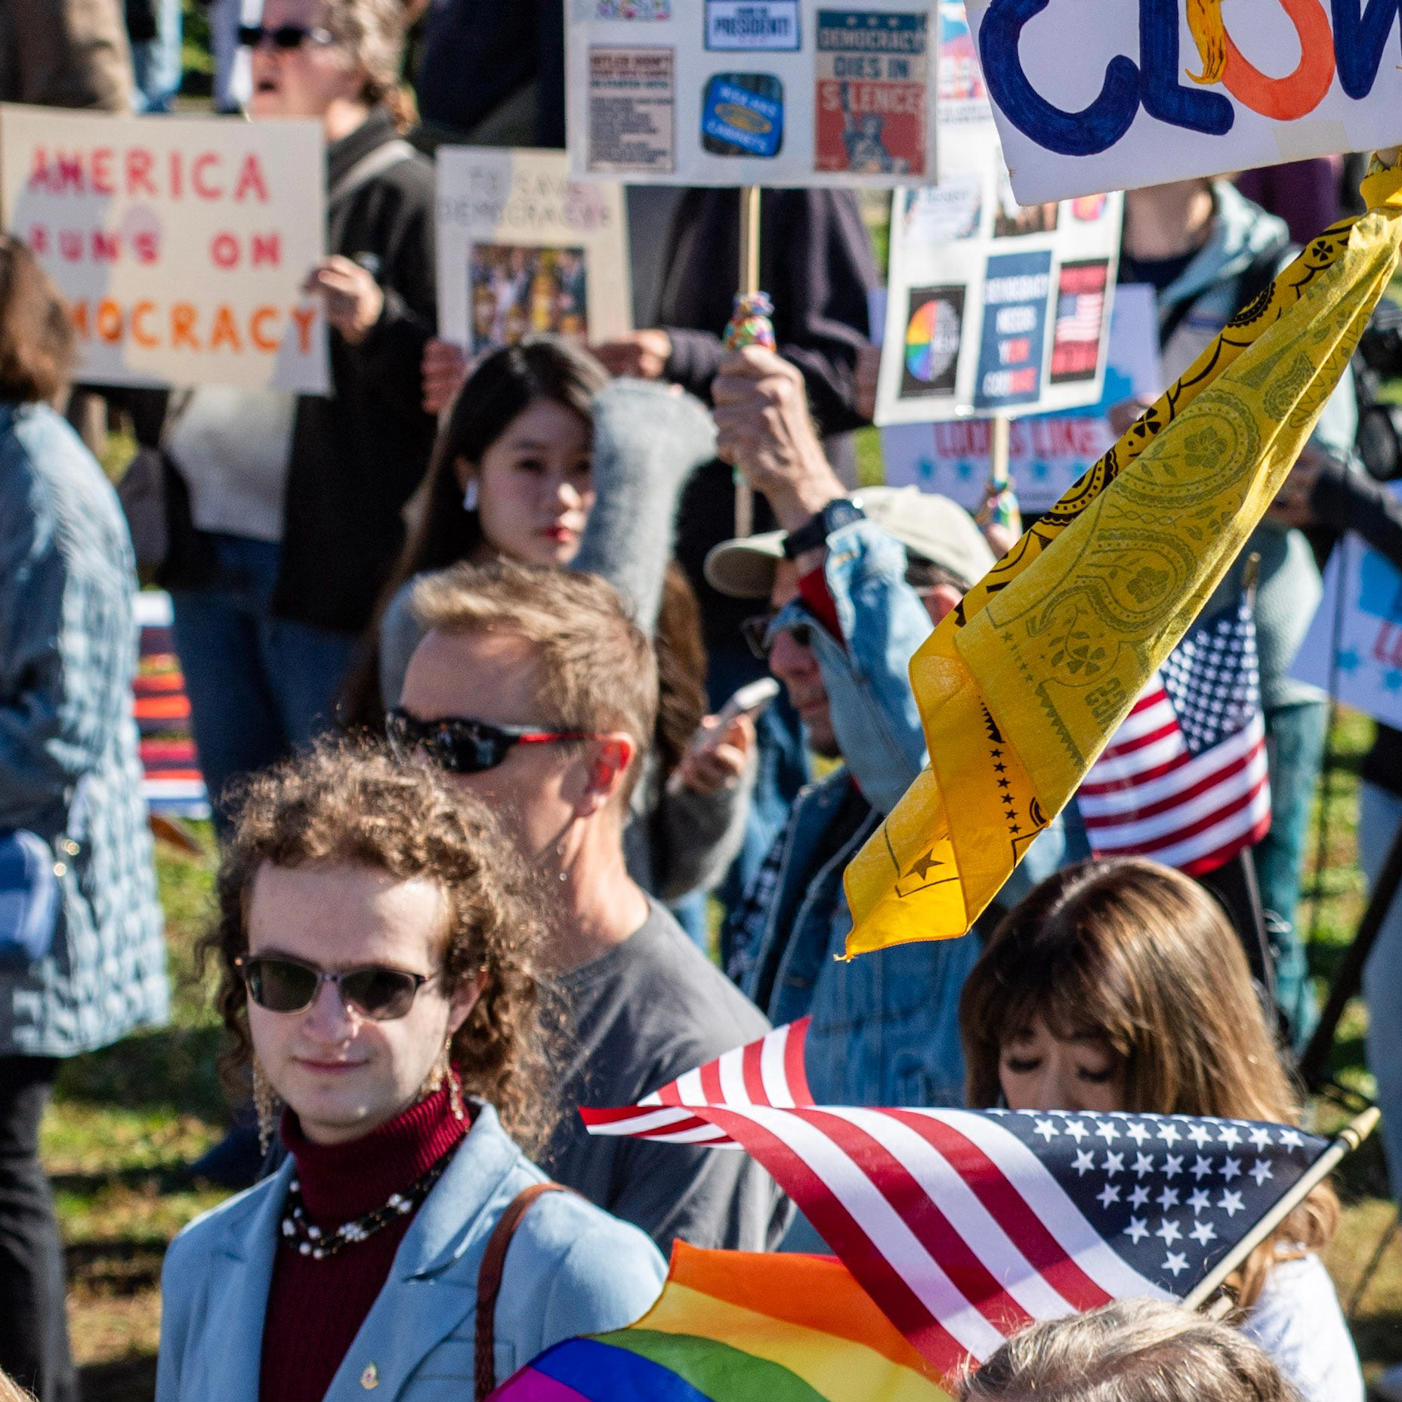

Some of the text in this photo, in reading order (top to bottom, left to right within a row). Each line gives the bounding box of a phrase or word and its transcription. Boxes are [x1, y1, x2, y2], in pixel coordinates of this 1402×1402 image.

[819, 30, 928, 51] DEMOCRACY
[833, 56, 910, 79] DIES IN
[27, 146, 271, 204] AMERICA
[28, 221, 282, 270] RUNS ON
[934, 417, 1026, 459] LOOS
